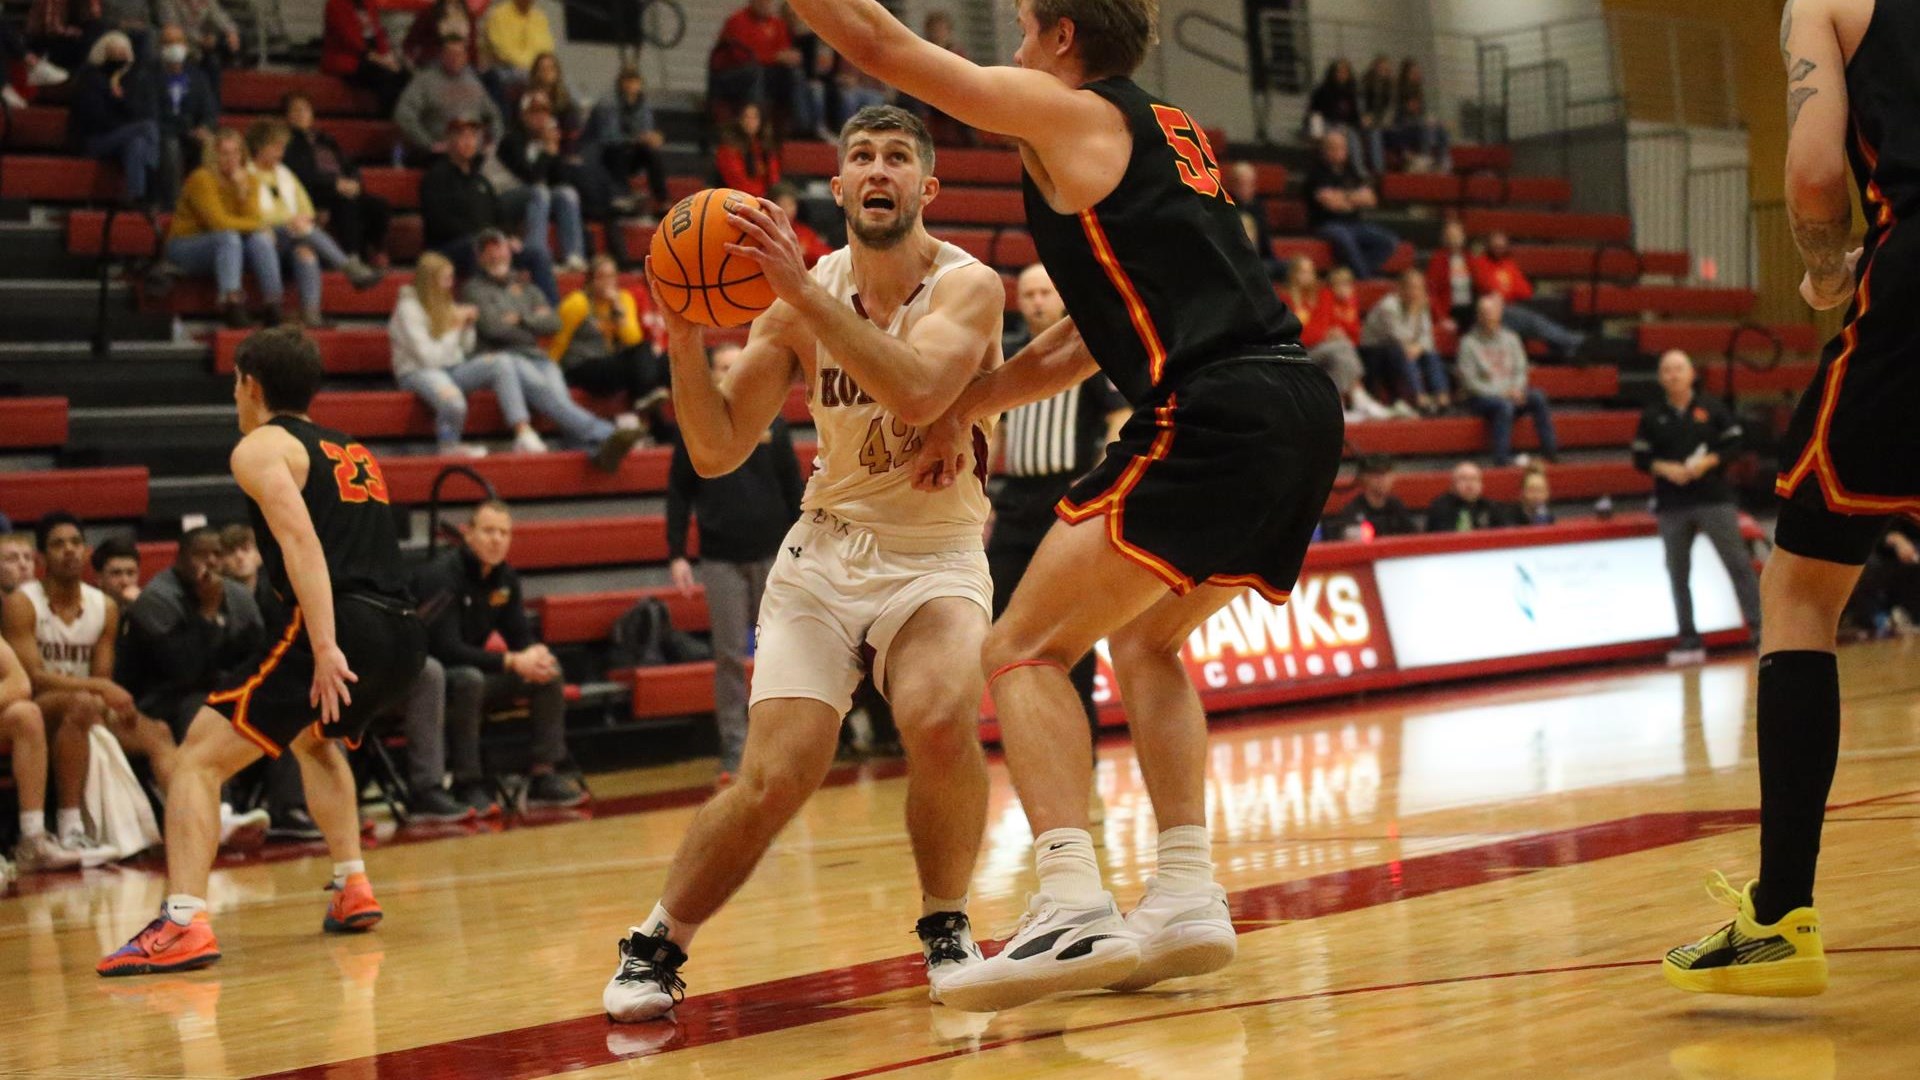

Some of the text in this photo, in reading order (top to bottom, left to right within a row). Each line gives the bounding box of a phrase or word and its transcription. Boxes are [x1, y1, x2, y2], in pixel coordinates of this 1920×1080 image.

[319, 440, 389, 505] 23
[1187, 573, 1371, 662] AWKS
[1203, 646, 1379, 689] College
